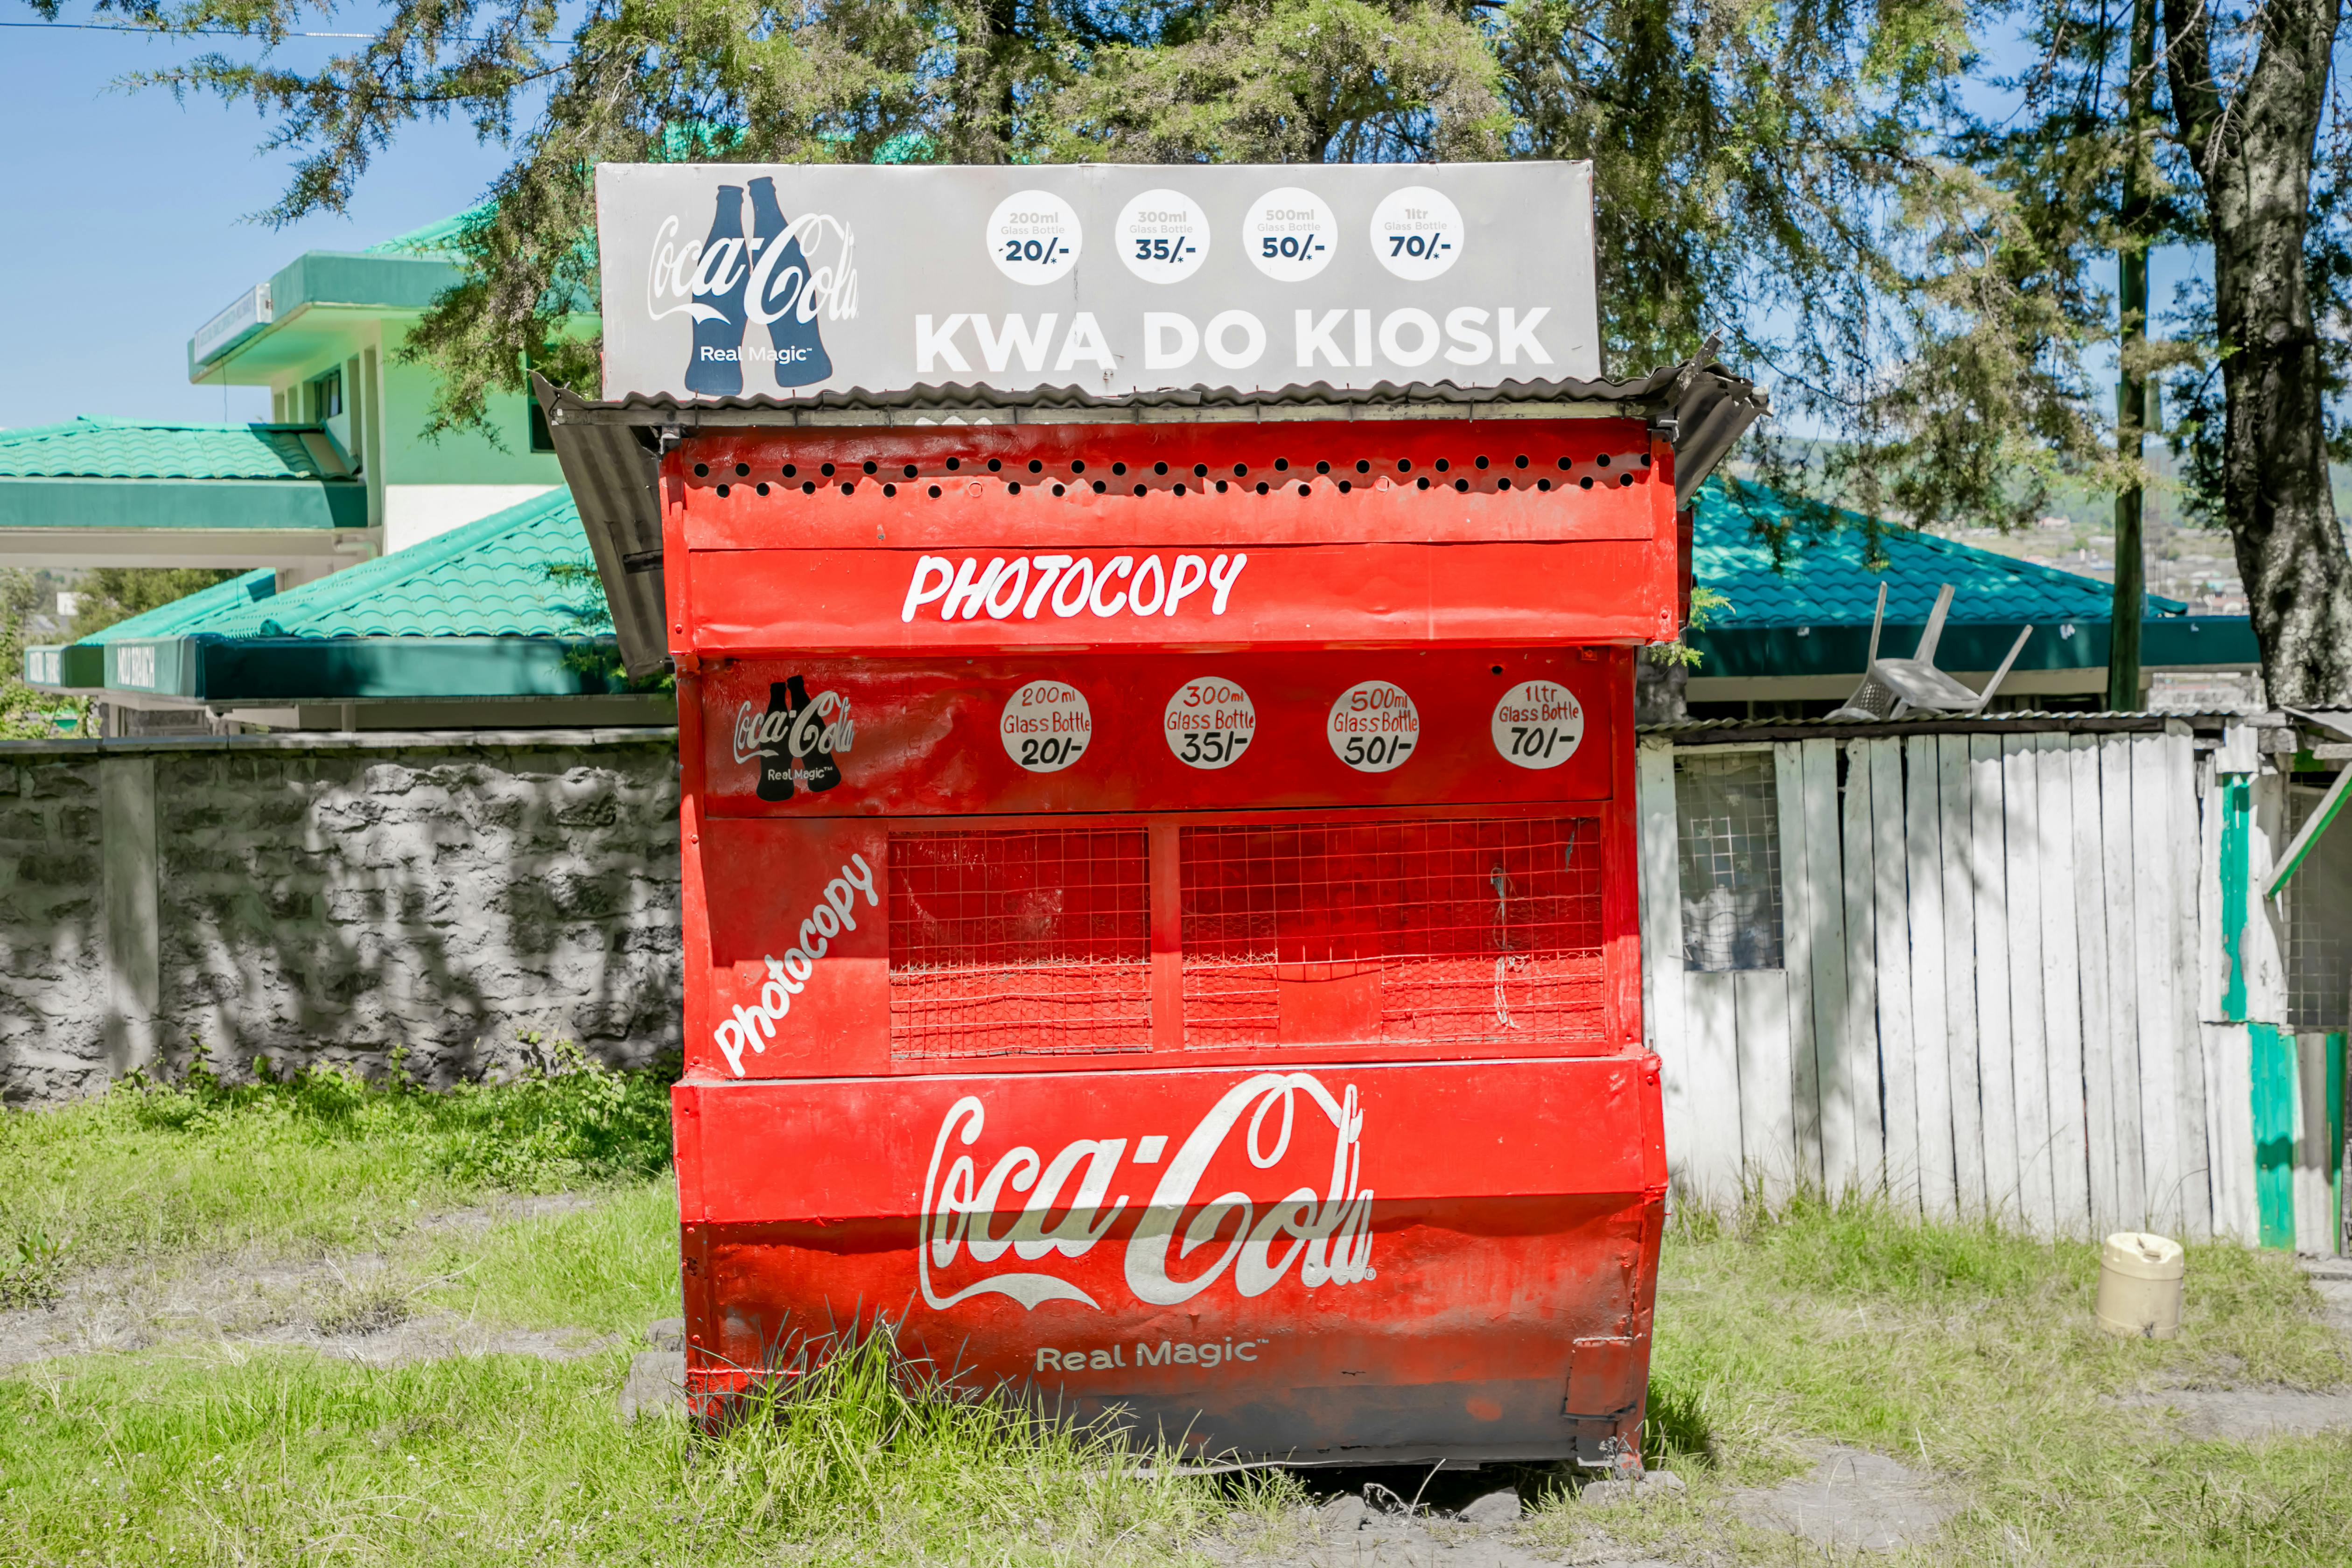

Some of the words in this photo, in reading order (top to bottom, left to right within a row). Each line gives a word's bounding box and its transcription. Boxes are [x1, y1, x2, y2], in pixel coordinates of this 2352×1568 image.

[1009, 212, 1059, 224] 200ml
[1138, 211, 1187, 223] 300ml
[1266, 210, 1314, 220] 500ml
[1001, 226, 1029, 235] Glass
[1032, 226, 1065, 234] Bottle
[1129, 224, 1158, 234] Glass
[1161, 224, 1193, 233] Bottle
[1288, 223, 1321, 231] Bottle
[1384, 222, 1412, 231] Glass
[1415, 221, 1447, 230] Bottle
[916, 312, 1117, 372] KWA
[1143, 309, 1267, 369] DO
[1295, 306, 1554, 367] KIOSK
[700, 346, 743, 362] Real
[901, 554, 1247, 623] PHOTOCOPY
[1022, 687, 1075, 707] 200ml
[1183, 686, 1244, 707] 300ml
[1351, 688, 1407, 711] 500ml
[1004, 714, 1049, 733] Glass
[1053, 711, 1091, 733] Bottle
[1166, 712, 1211, 730] Glass
[1215, 709, 1254, 729] Bottle
[1334, 712, 1379, 732] Glass
[1382, 709, 1418, 732] Bottle
[1499, 705, 1539, 722] Glass
[1542, 701, 1579, 721] Bottle
[733, 690, 855, 764] Coca-Cola
[1021, 737, 1082, 765] 20/-
[1180, 731, 1248, 763] 35/-
[1344, 735, 1412, 765] 50/-
[1511, 727, 1575, 758] 70/-
[768, 768, 792, 781] Real
[1036, 1345, 1126, 1372] Real
